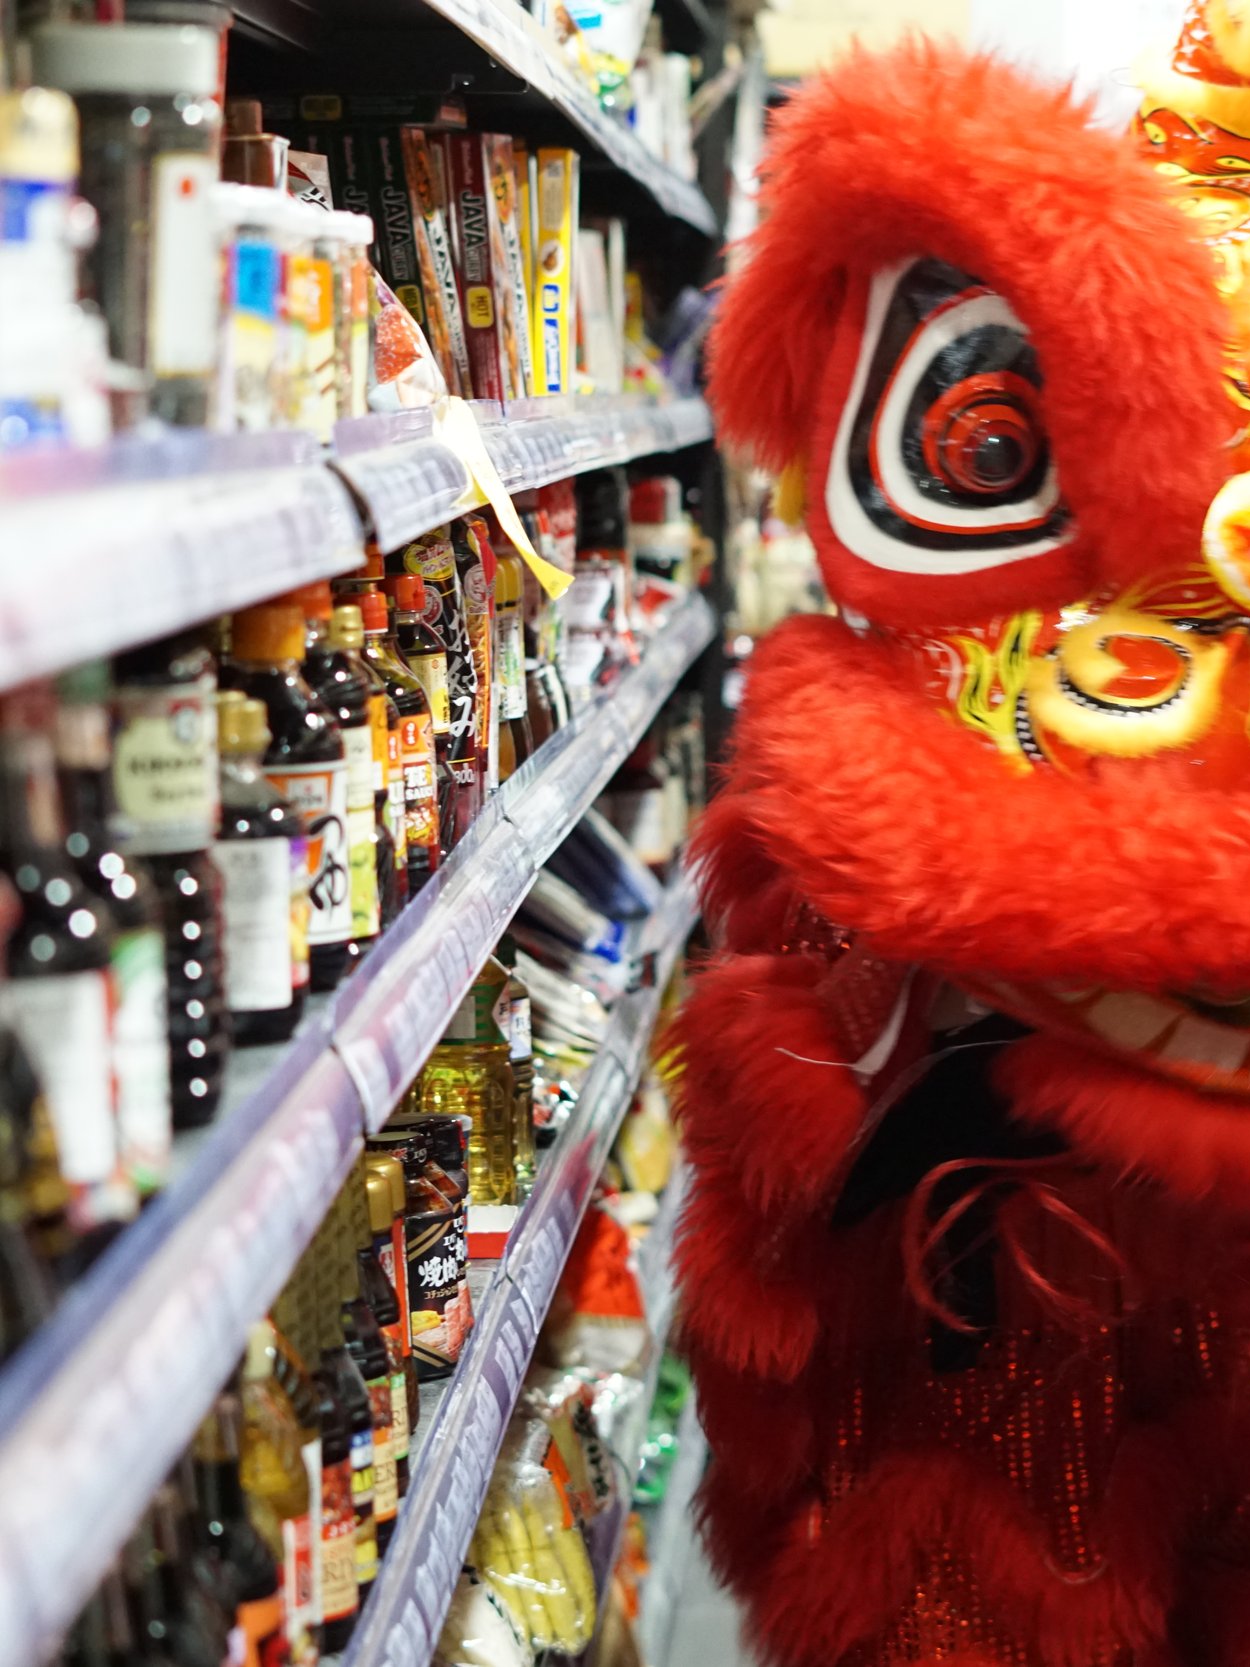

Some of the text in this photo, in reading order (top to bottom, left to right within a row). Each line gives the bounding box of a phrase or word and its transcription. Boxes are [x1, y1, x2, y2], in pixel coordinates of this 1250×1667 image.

[381, 186, 413, 248] JAVA
[461, 190, 487, 248] JAVA
[473, 294, 490, 319] HOT
